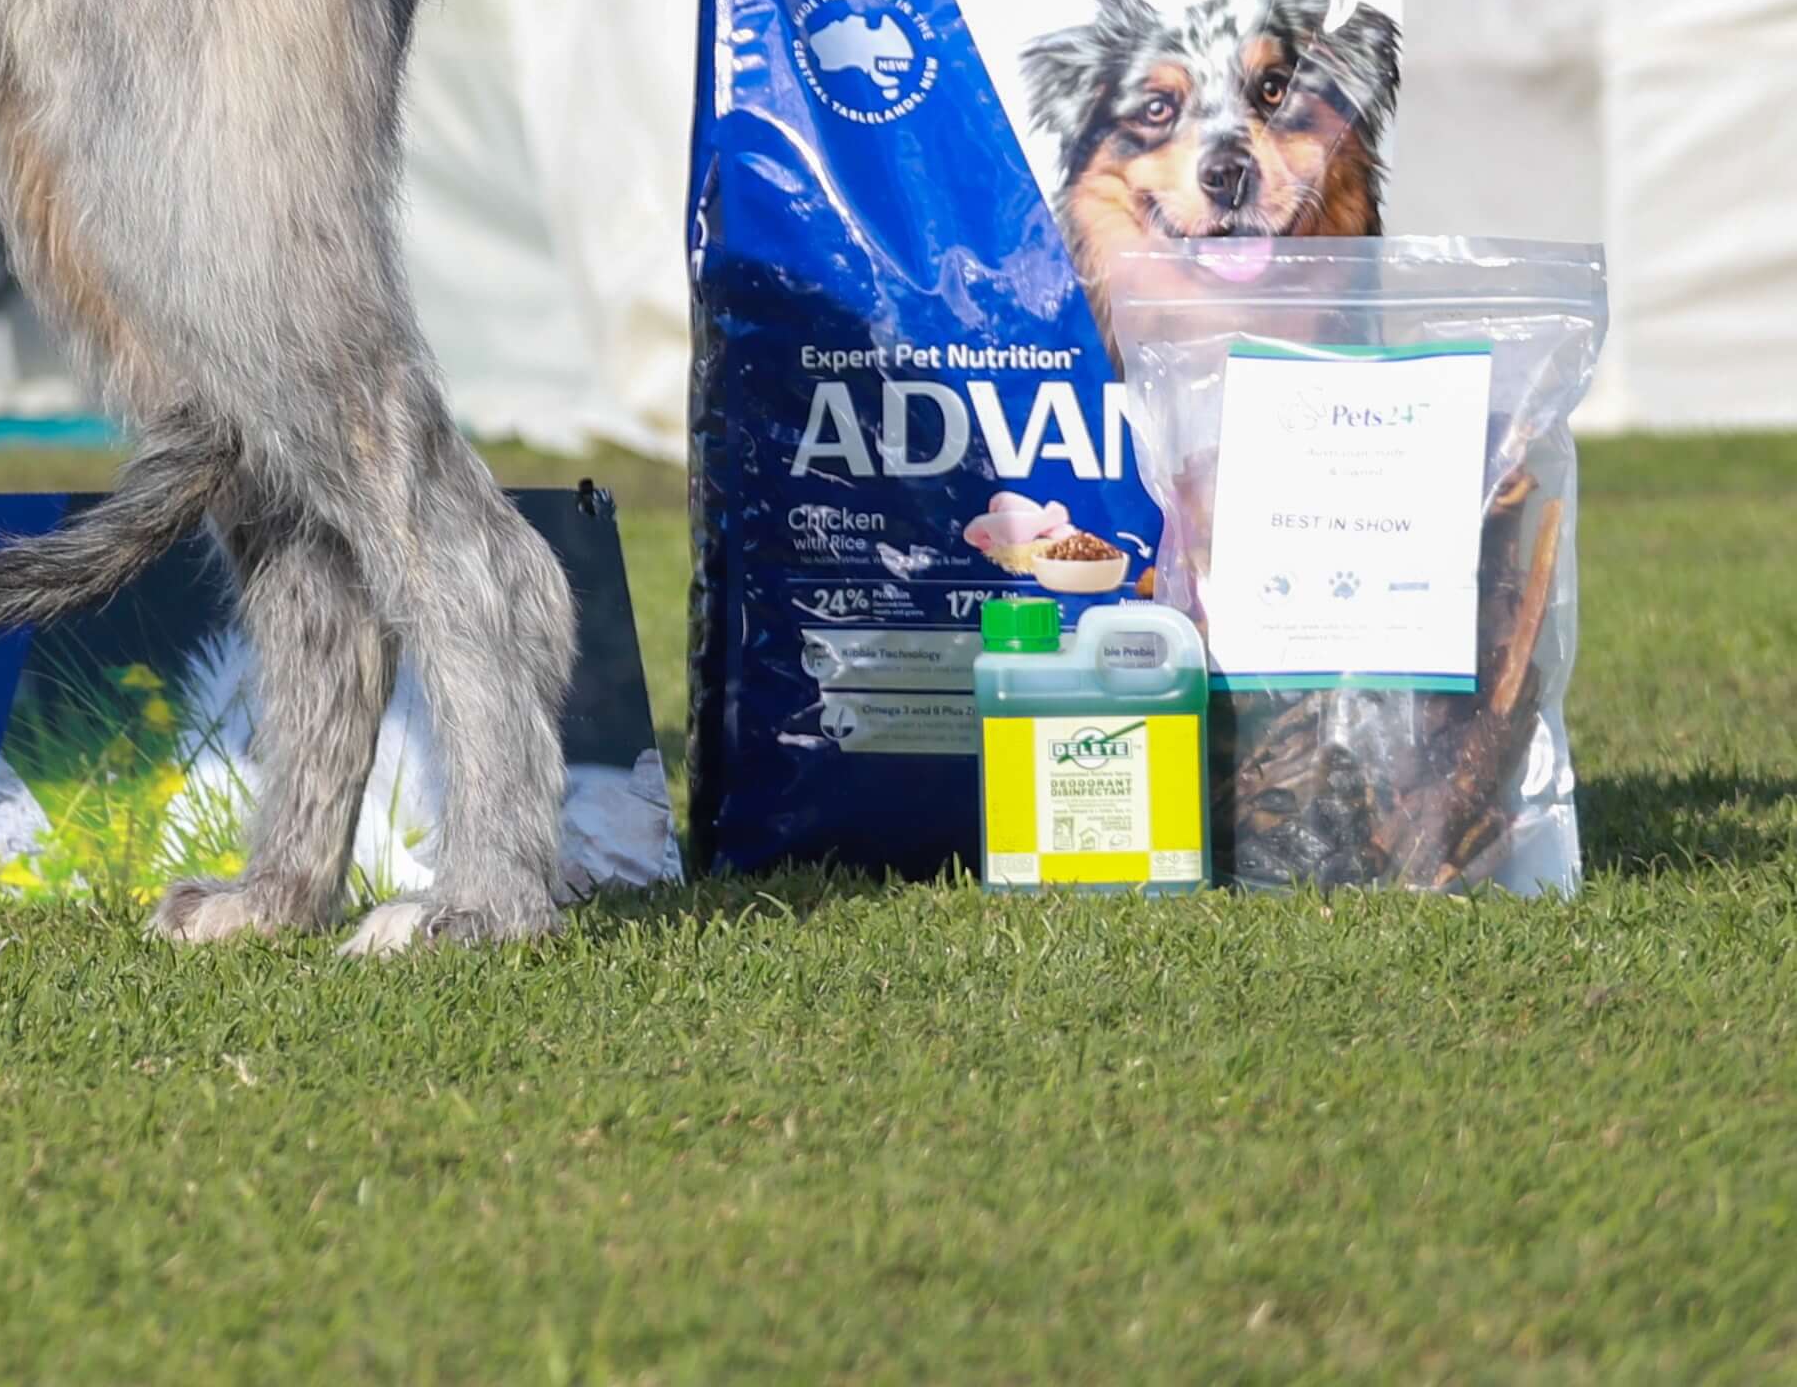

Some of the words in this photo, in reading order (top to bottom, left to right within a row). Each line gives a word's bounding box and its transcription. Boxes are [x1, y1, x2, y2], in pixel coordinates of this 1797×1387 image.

[913, 13, 935, 41] THE
[878, 60, 910, 72] NSW
[801, 345, 887, 372] Expert
[895, 344, 941, 369] Pet
[788, 506, 886, 531] Chicken
[1271, 513, 1323, 529] BEST
[1328, 517, 1346, 531] IN
[1354, 517, 1413, 533] SHOW
[793, 536, 827, 550] with
[830, 535, 866, 550] Rice
[813, 589, 869, 614] 24%
[879, 649, 941, 660] Technology
[1053, 742, 1128, 757] DELETE
[1050, 778, 1132, 787] DEODORANT
[1050, 787, 1131, 796] DISINFECTANT
